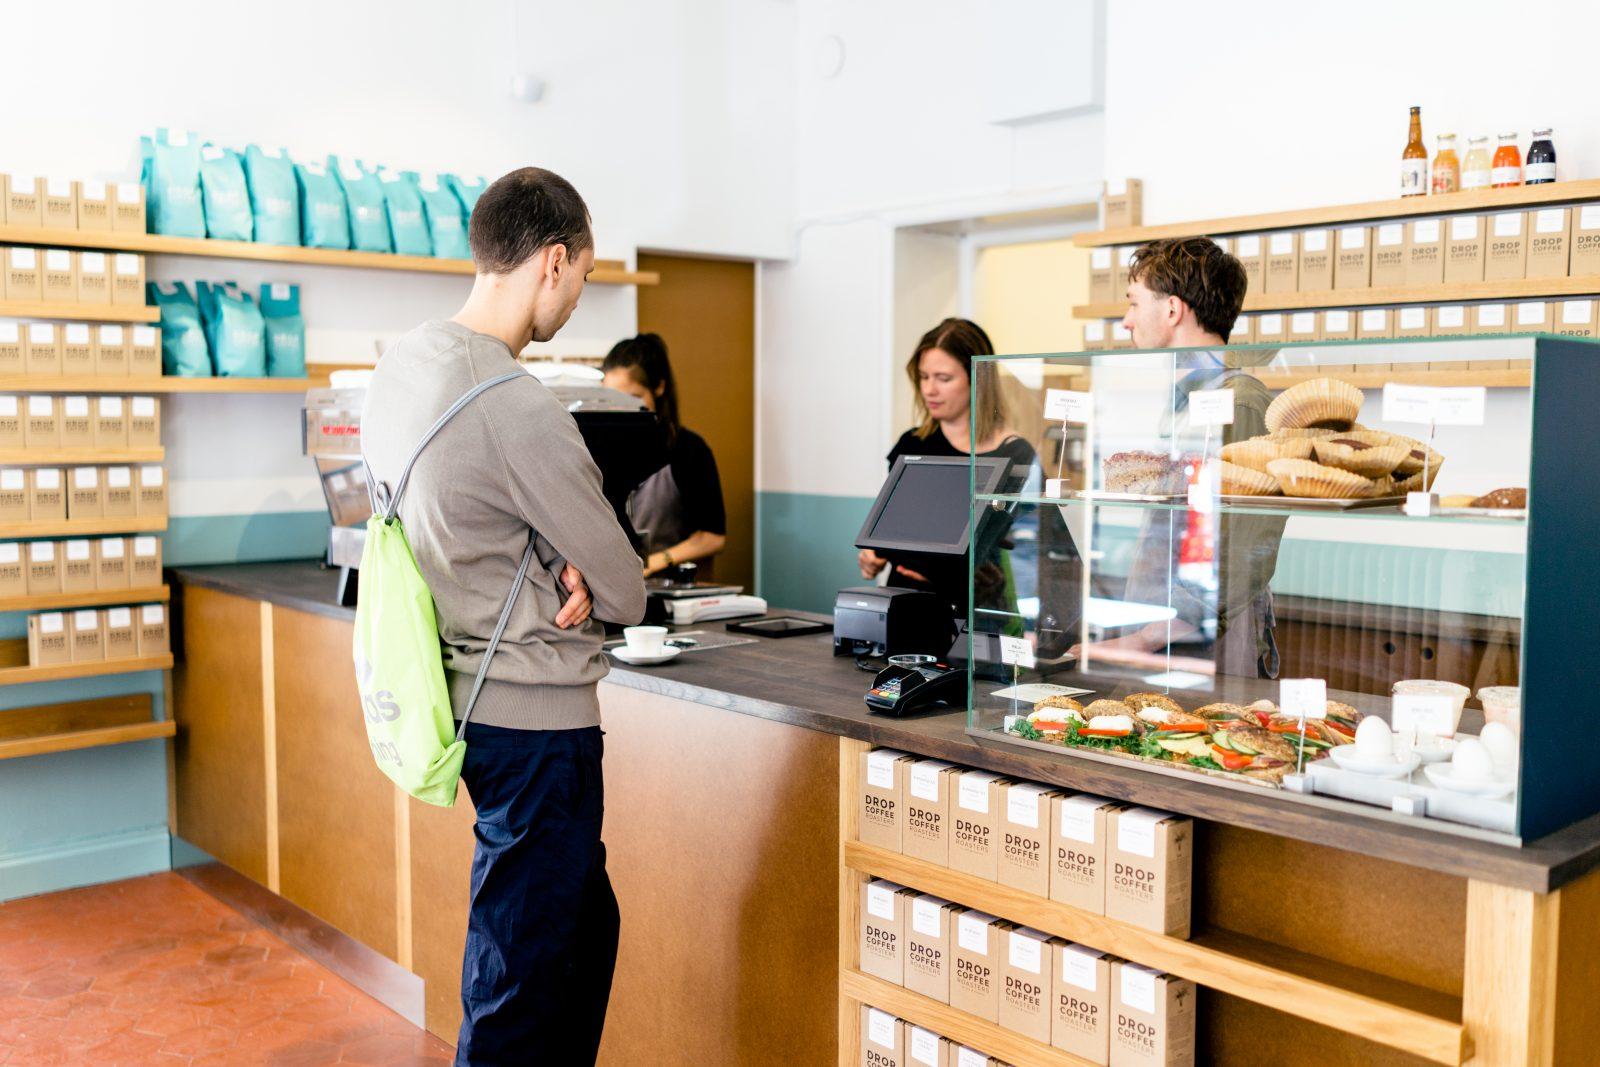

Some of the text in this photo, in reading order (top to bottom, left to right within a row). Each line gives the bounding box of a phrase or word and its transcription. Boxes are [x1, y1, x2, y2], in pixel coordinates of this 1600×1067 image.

[1492, 242, 1520, 250] DROP
[1533, 238, 1562, 246] DROP
[1578, 235, 1600, 243] DRO
[1377, 252, 1402, 260] DROP
[1412, 247, 1438, 255] DROP
[1451, 245, 1478, 253] DROP
[865, 795, 895, 809] DROP
[865, 806, 894, 819] COFFEE
[909, 807, 940, 823] DROP
[909, 819, 940, 832] COFFEE
[956, 820, 990, 836] DROP
[956, 832, 989, 846] COFFEE
[1005, 833, 1040, 851] DROP
[1005, 845, 1039, 861] COFFEE
[1058, 848, 1096, 866] DROP
[1058, 860, 1095, 877] COFFEE
[1115, 863, 1155, 882] DROP
[1115, 876, 1155, 893] COFFEE
[866, 925, 897, 942] DROP
[866, 936, 896, 951] COFFEE
[910, 942, 941, 959] DROP
[910, 953, 941, 969] COFFEE
[957, 958, 990, 977] DROP
[957, 970, 990, 987] COFFEE
[1006, 976, 1041, 996] DROP
[1005, 989, 1040, 1006] COFFEE
[1060, 995, 1098, 1014] DROP
[1060, 1007, 1097, 1026] COFFEE
[1118, 1015, 1156, 1036] DROP
[1118, 1028, 1155, 1048] COFFEE
[867, 1050, 896, 1067] DROP
